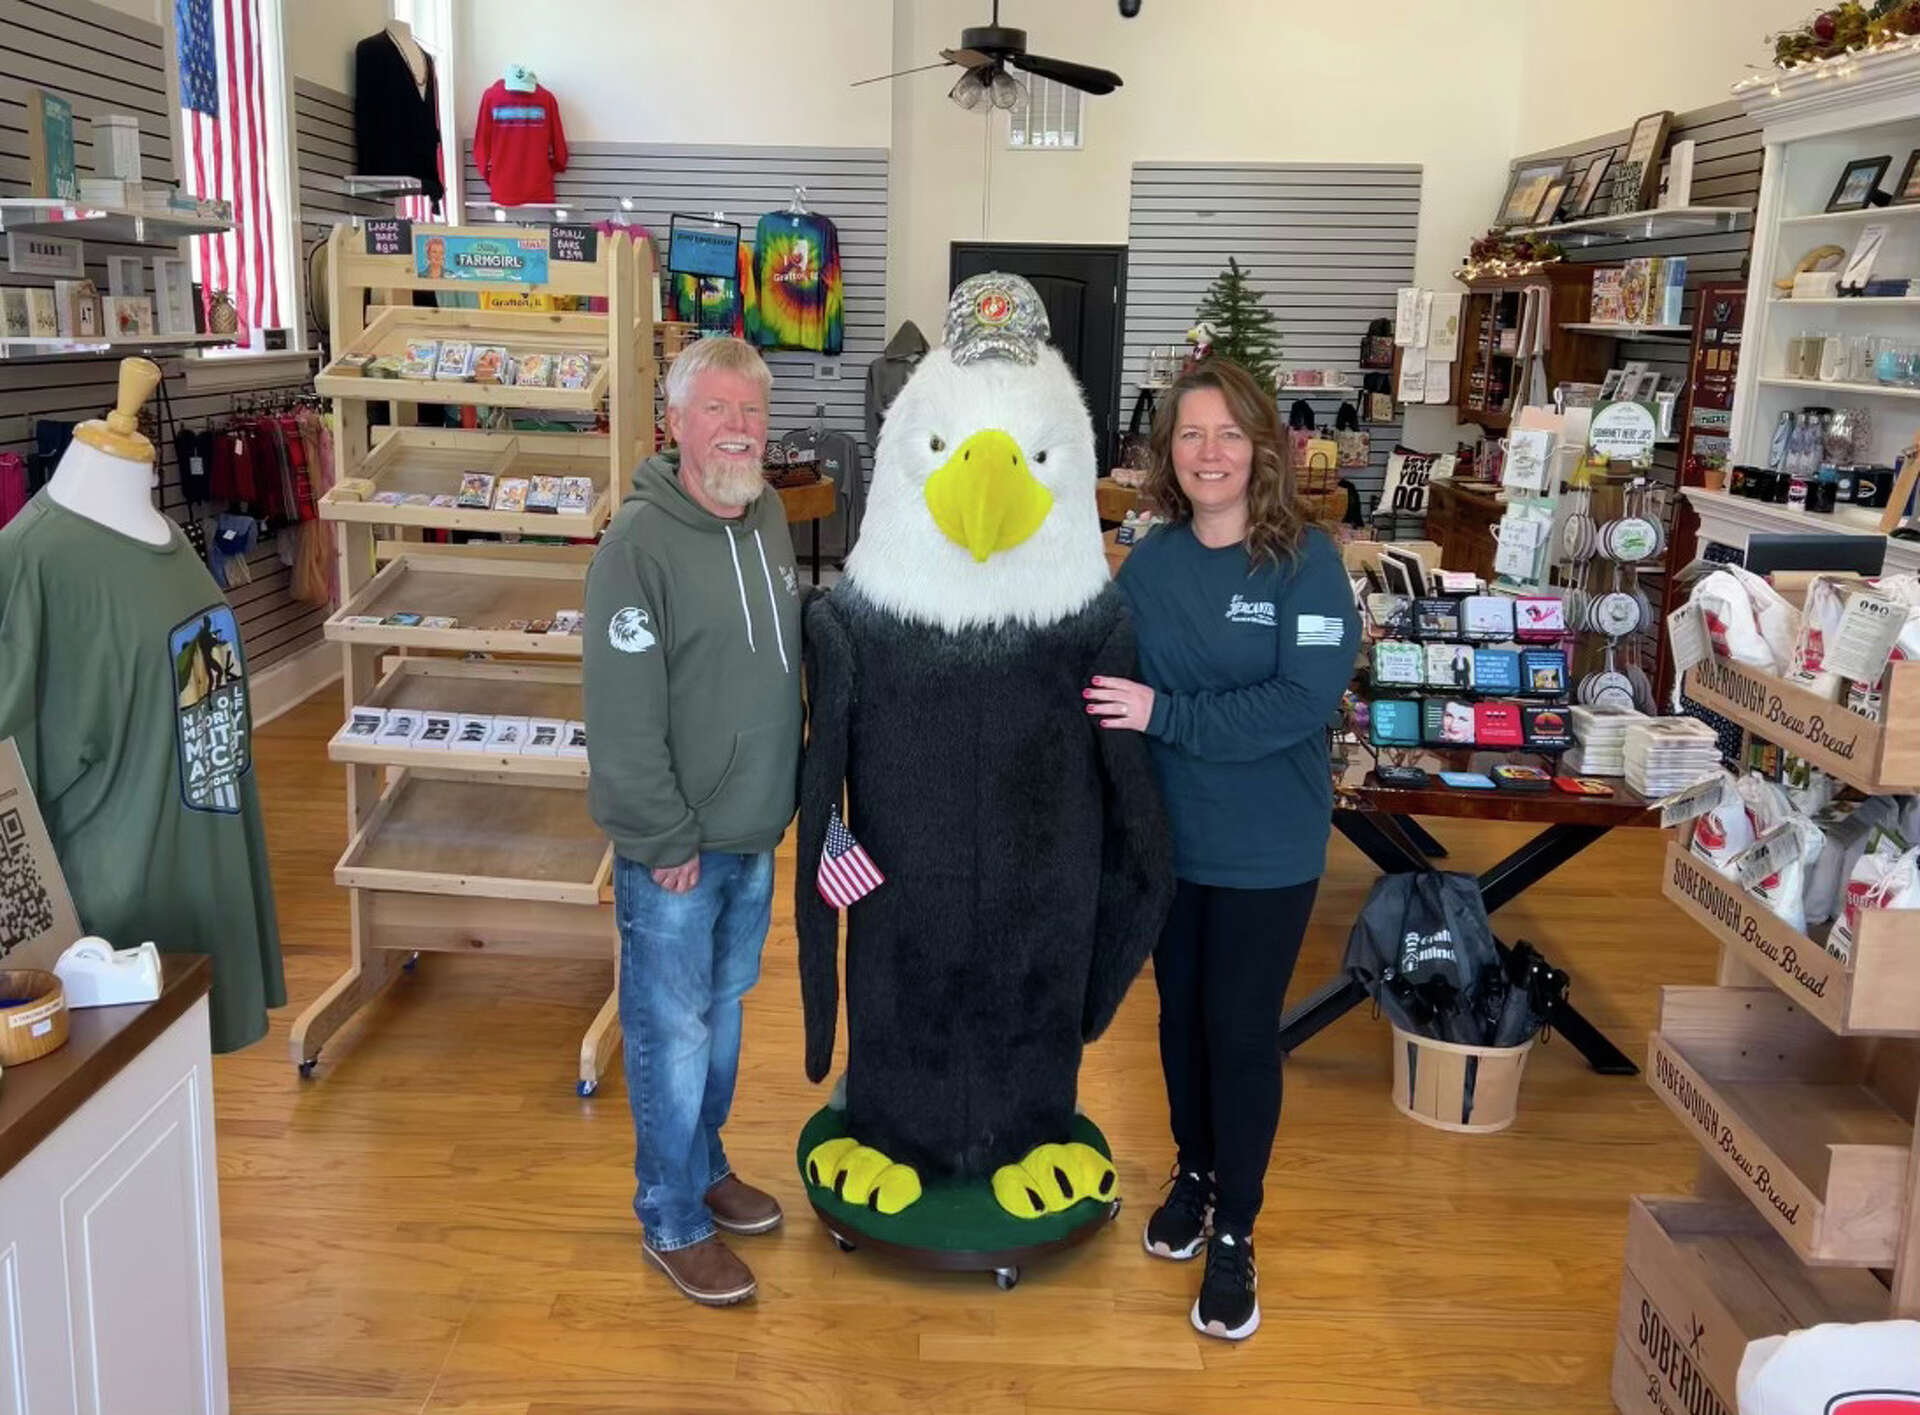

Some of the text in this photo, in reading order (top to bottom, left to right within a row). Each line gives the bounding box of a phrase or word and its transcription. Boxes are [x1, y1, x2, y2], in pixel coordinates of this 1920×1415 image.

[459, 254, 522, 268] FARMGIRL
[552, 228, 585, 240] SMALL
[1399, 471, 1430, 487] YOU
[1697, 658, 1858, 760] SOBERDOUGH Brew Bread
[1673, 858, 1829, 998] SOBERDOUGH Brew Bread
[1656, 1050, 1800, 1225] SOBERDOUGH Brew Bread
